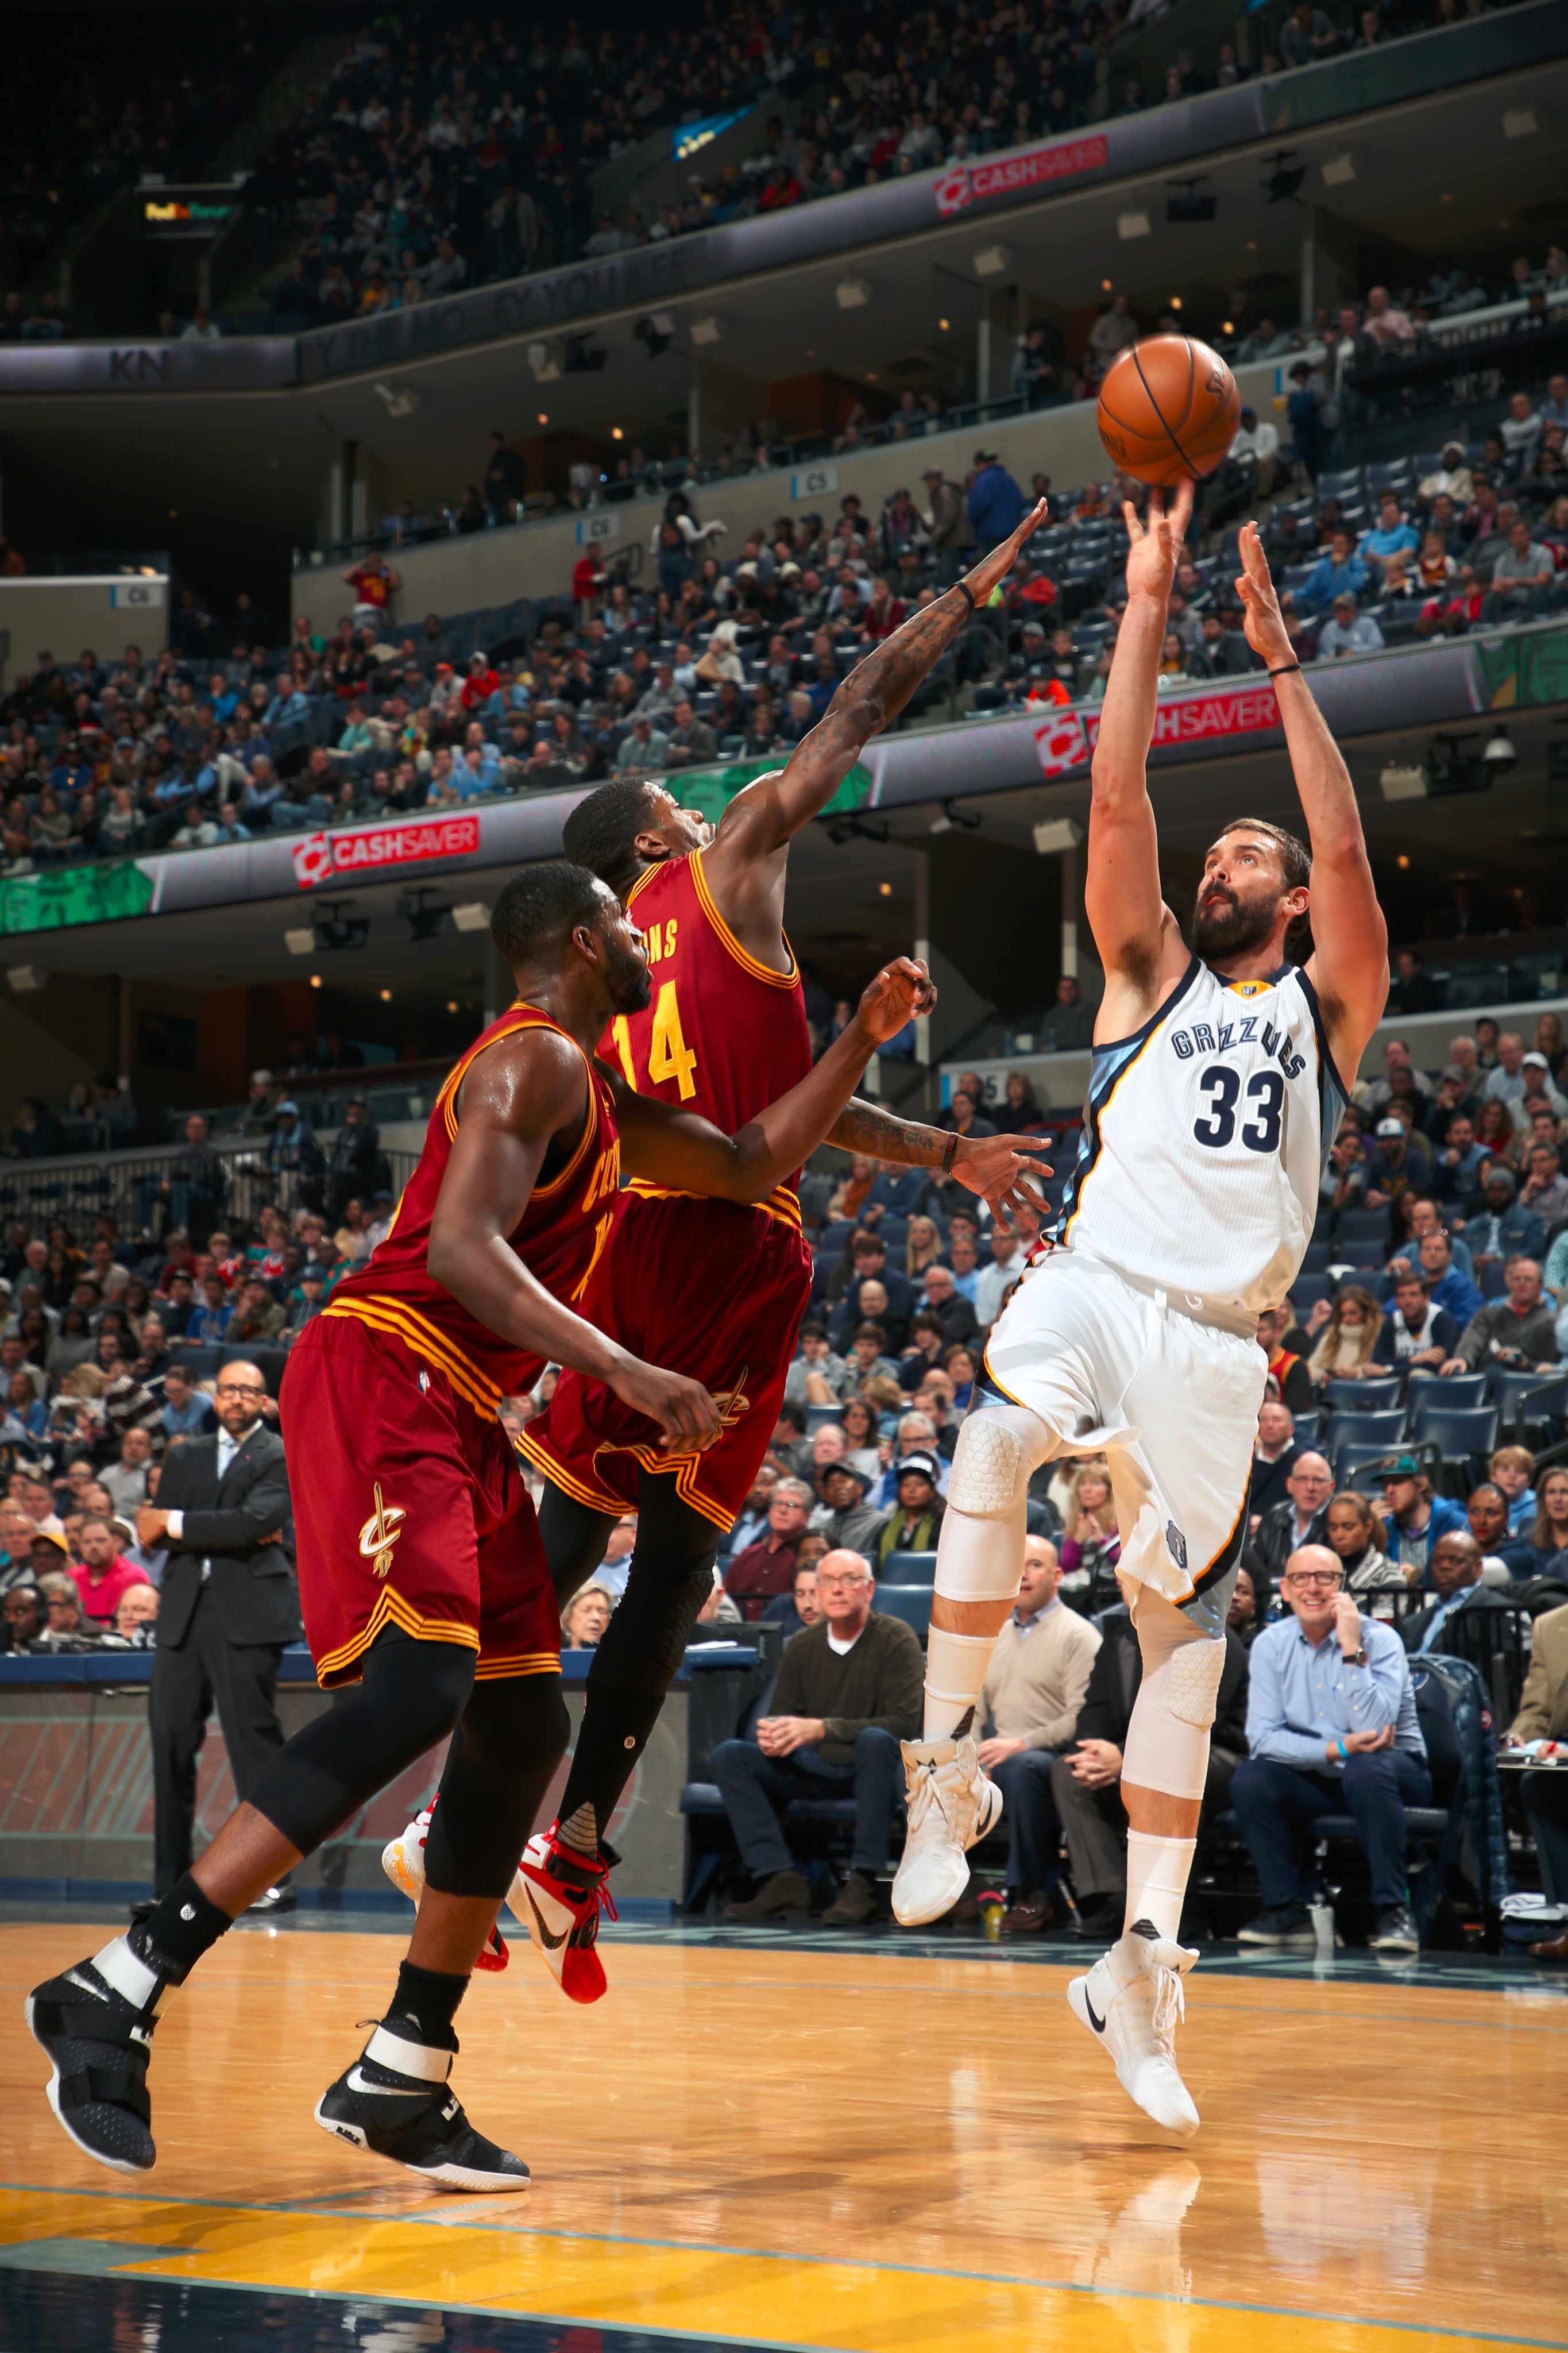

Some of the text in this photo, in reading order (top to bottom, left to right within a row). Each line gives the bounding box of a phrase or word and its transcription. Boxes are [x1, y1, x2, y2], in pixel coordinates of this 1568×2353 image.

[972, 141, 1104, 193] CASHSAVER
[806, 471, 827, 492] C5
[333, 821, 476, 867] CASHSAVER
[612, 978, 697, 1102] 14
[1193, 1065, 1285, 1154] 33
